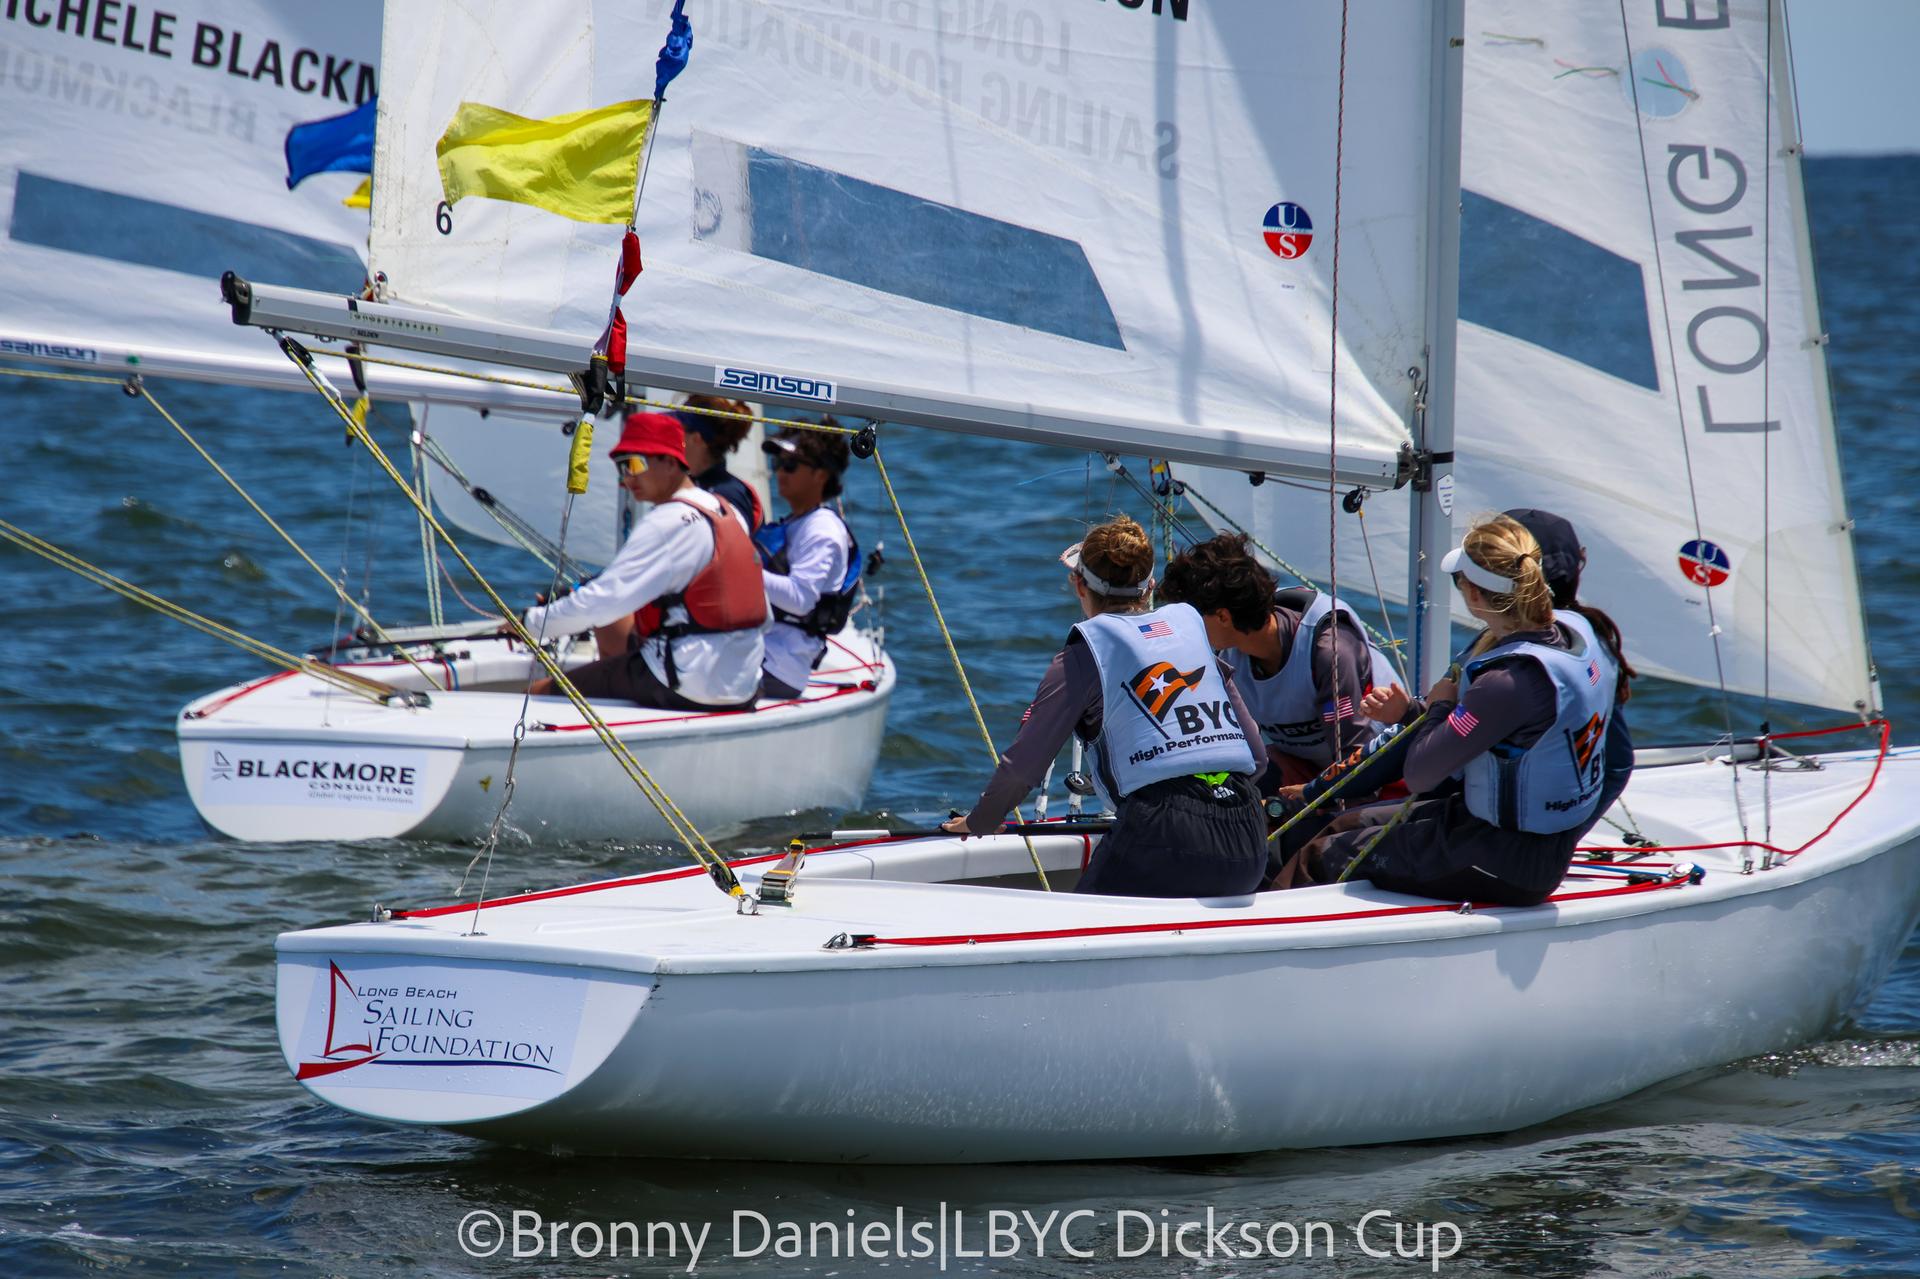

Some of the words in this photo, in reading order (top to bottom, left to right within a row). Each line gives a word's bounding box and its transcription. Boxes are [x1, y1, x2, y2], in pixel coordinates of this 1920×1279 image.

[436, 200, 453, 236] 6
[1129, 745, 1165, 766] High
[237, 759, 417, 785] BLACKMORE
[309, 781, 415, 796] CONSULTING
[363, 999, 474, 1029] SAILING
[375, 1027, 554, 1065] FOUNDATION
